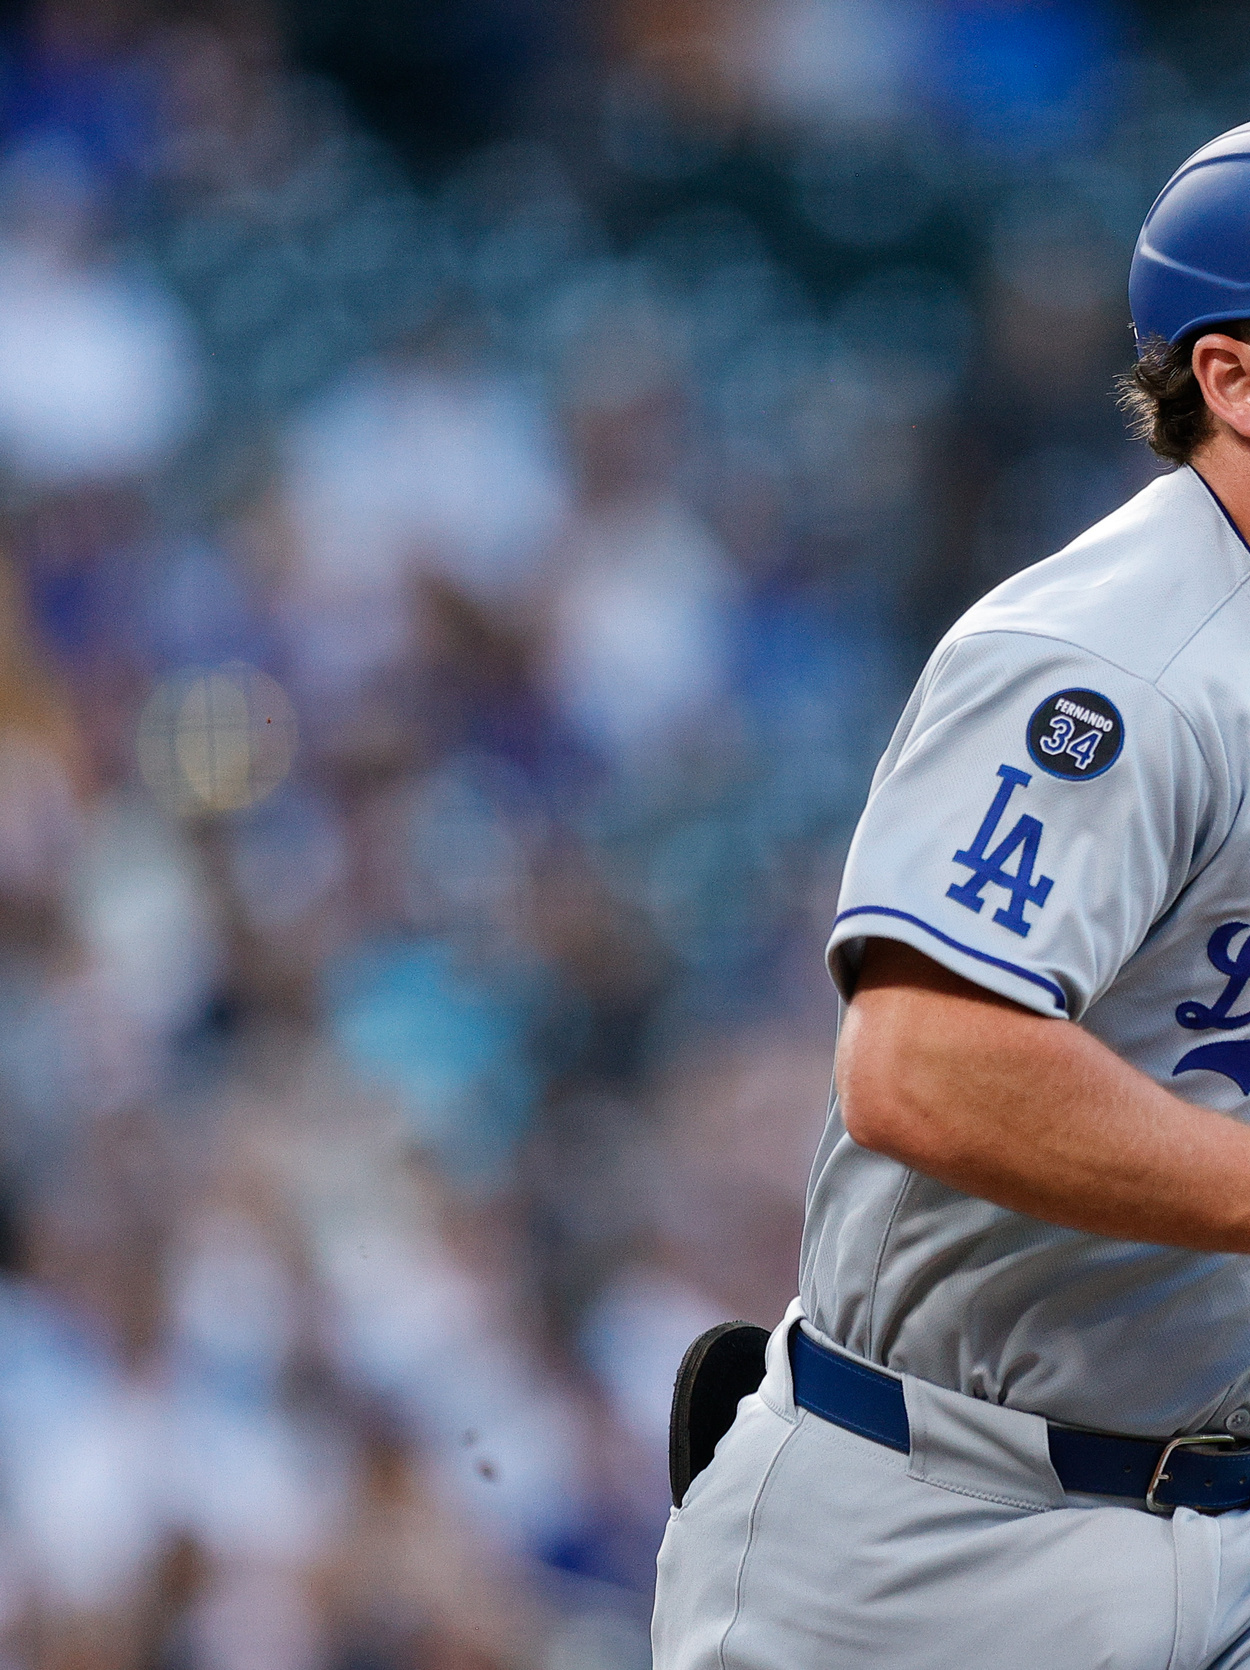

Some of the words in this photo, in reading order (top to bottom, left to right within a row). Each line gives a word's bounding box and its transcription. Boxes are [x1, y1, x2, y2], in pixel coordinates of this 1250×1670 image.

[1040, 715, 1103, 770] 34
[1055, 698, 1113, 732] FERNANDO
[945, 764, 1055, 939] LA
